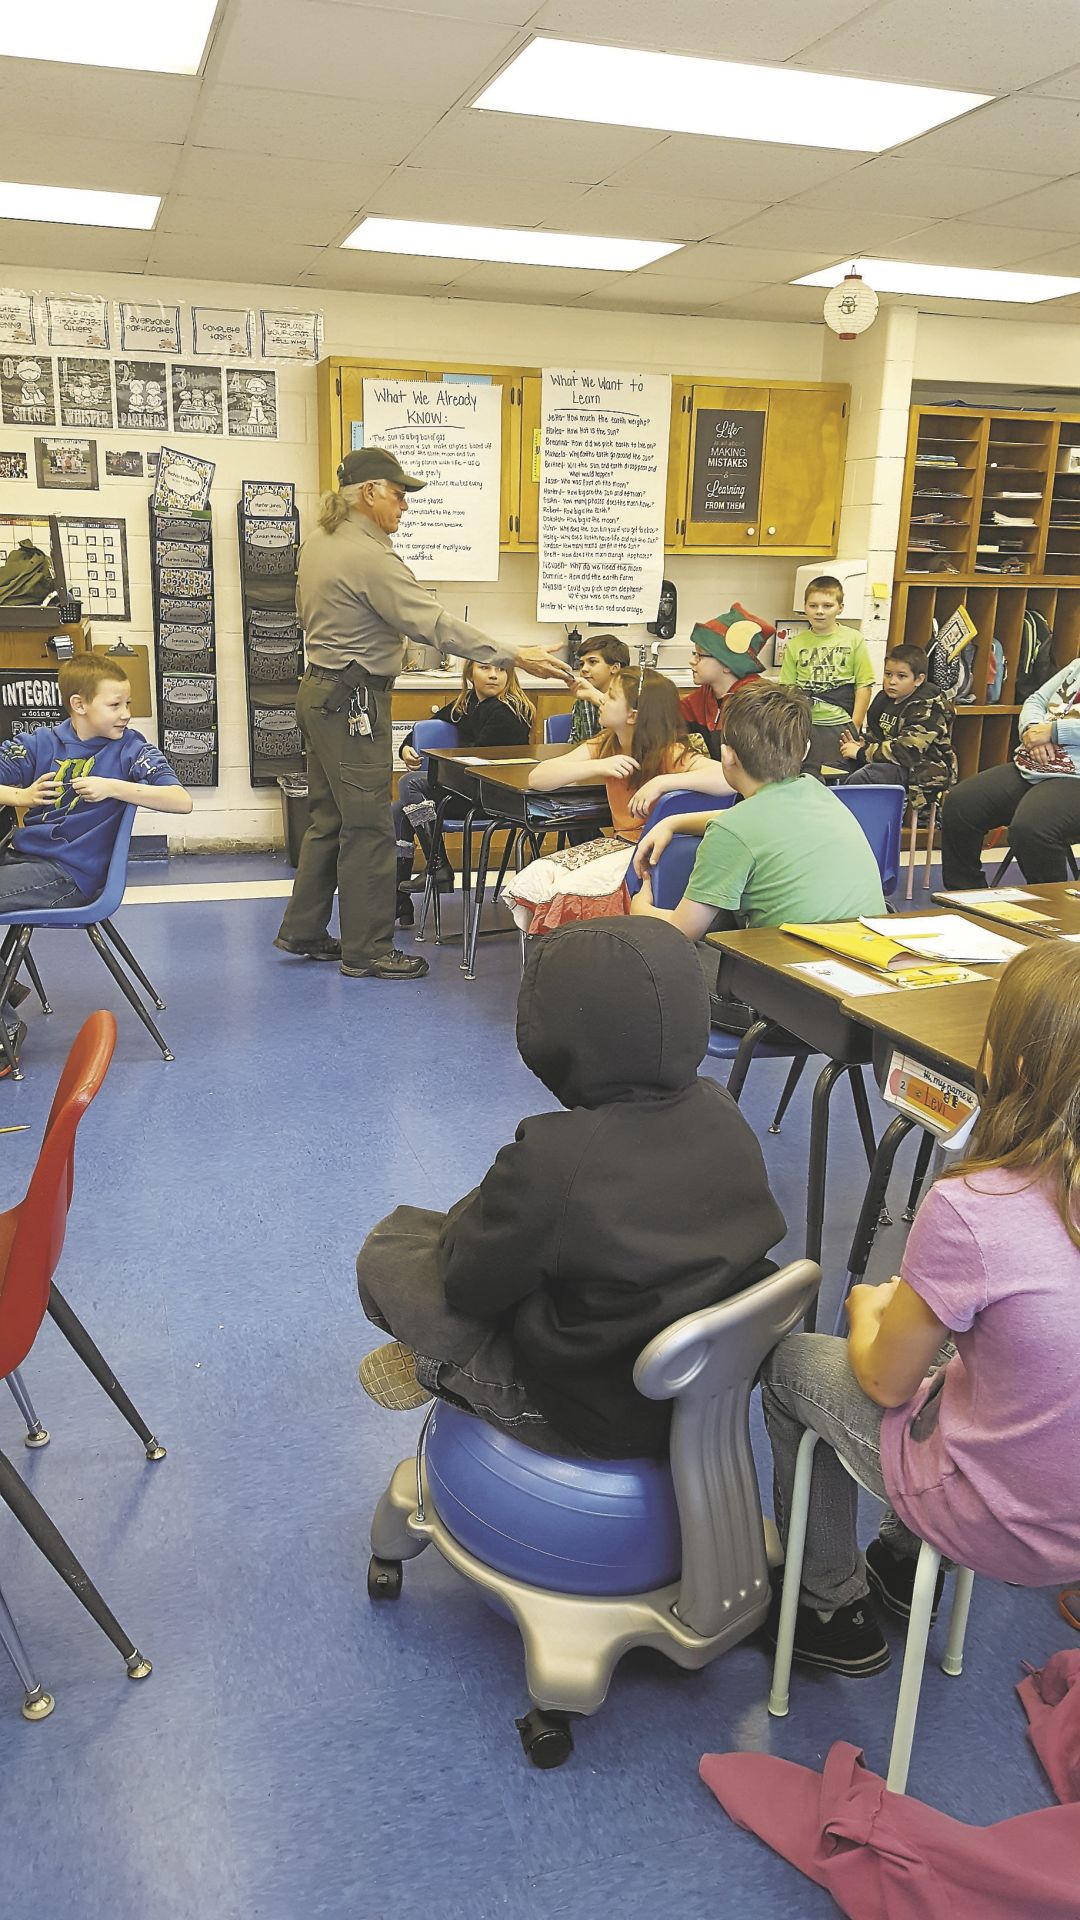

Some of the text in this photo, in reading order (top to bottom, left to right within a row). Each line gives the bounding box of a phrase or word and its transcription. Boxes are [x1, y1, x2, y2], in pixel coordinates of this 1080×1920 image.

[175, 367, 187, 390] 3
[230, 371, 241, 393] 4
[550, 374, 644, 392] What We Want to
[374, 388, 478, 412] What We Already
[572, 390, 601, 404] Learn
[64, 408, 109, 426] WHISPER
[120, 412, 166, 428] PARTNERS
[180, 414, 218, 431] GROUPS
[580, 414, 595, 422] much
[715, 420, 743, 438] Life
[710, 447, 746, 457] MAKING
[707, 458, 748, 468] MISTAKES
[723, 471, 729, 479] &
[706, 480, 745, 499] Learning
[705, 501, 745, 510] FROM THEM
[799, 646, 851, 668] CAN'T
[2, 680, 63, 707] INTEGRIT
[900, 1080, 906, 1090] 2
[933, 1076, 946, 1092] my
[946, 1084, 966, 1100] name
[924, 1086, 946, 1116] Levi
